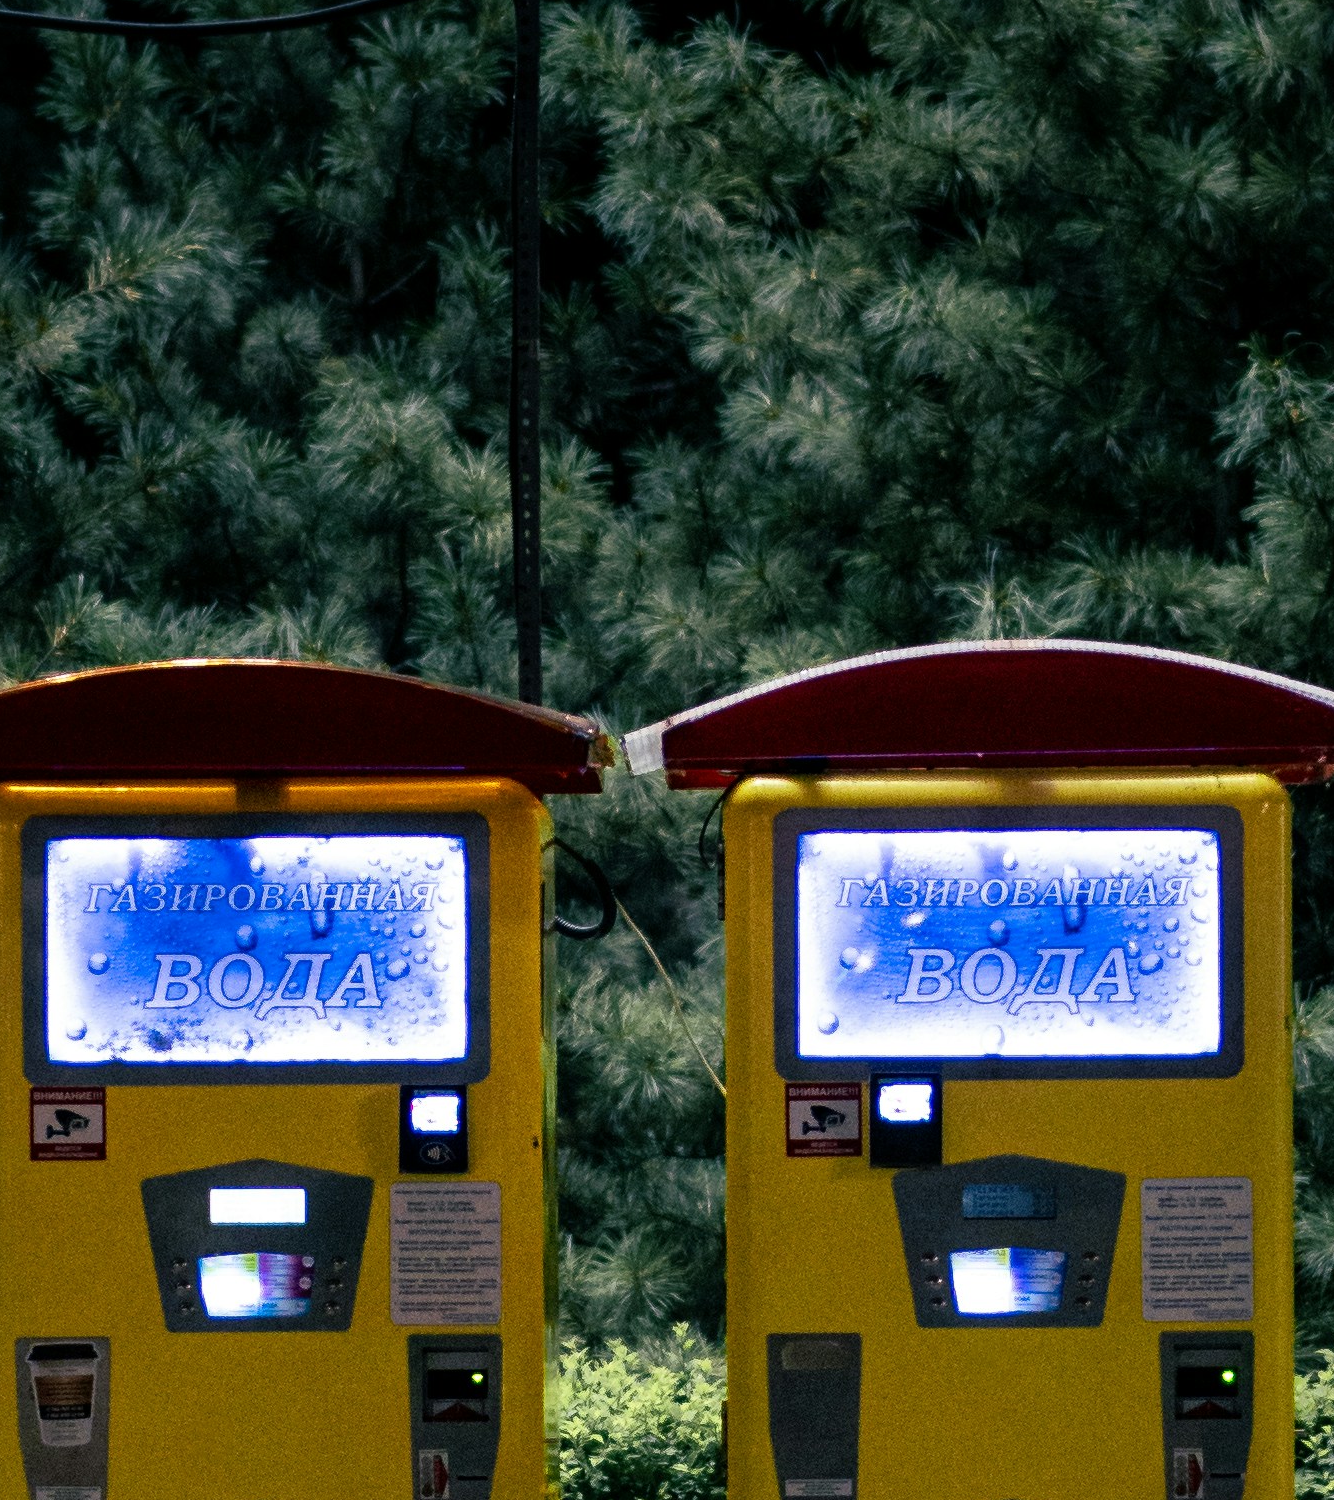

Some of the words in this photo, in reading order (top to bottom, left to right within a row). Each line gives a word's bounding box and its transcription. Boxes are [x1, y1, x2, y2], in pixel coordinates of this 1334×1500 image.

[85, 883, 439, 913] ГАЗИРОВАННАЯ
[837, 878, 1192, 908] ГАЗИРОВАННАЯ
[143, 952, 384, 1020] ВОДА
[895, 946, 1137, 1015] ВОДА
